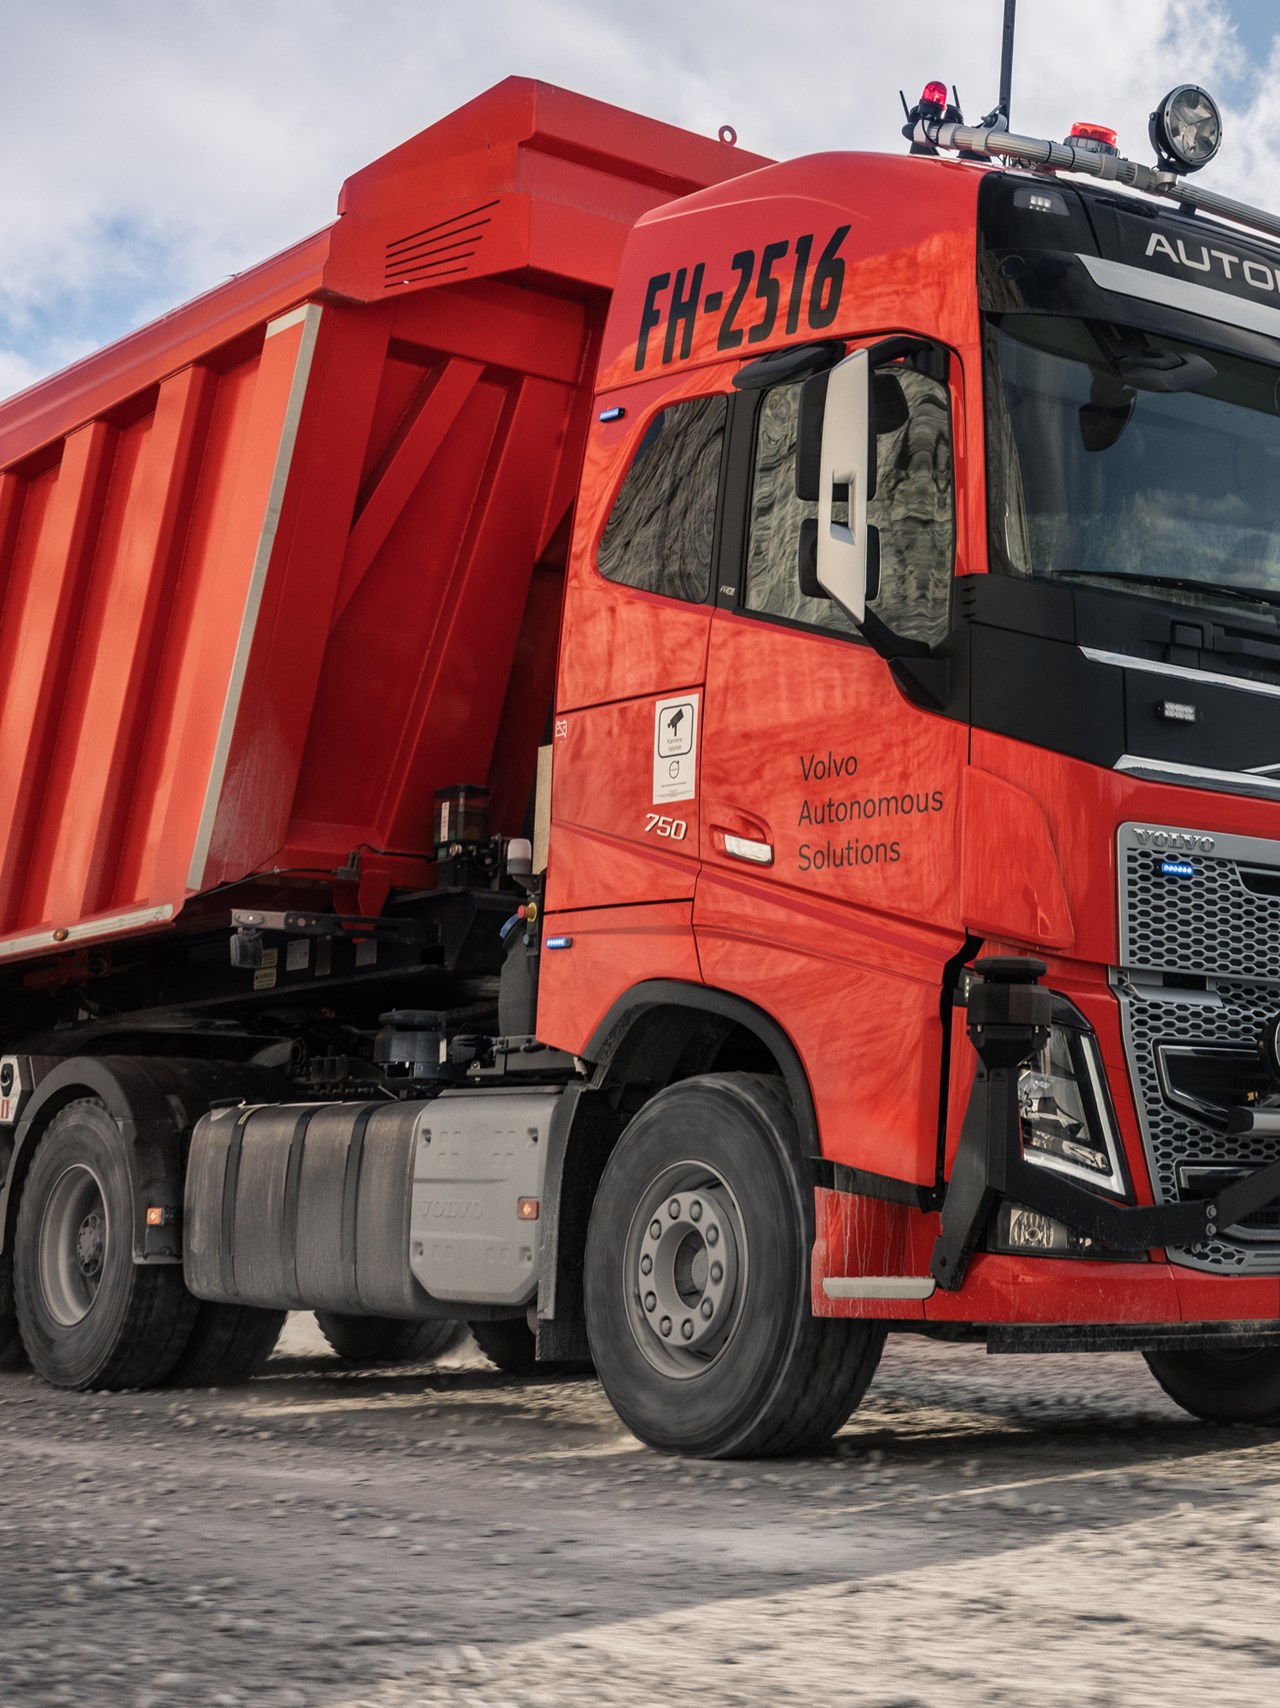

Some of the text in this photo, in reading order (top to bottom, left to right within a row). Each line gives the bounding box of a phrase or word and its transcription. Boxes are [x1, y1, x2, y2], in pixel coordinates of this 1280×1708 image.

[634, 224, 852, 371] FH-2516
[800, 752, 858, 782] Volvo
[798, 790, 944, 827] Autonomous
[644, 813, 687, 840] 750
[1133, 828, 1215, 853] VOLVO
[798, 838, 901, 871] Solutions
